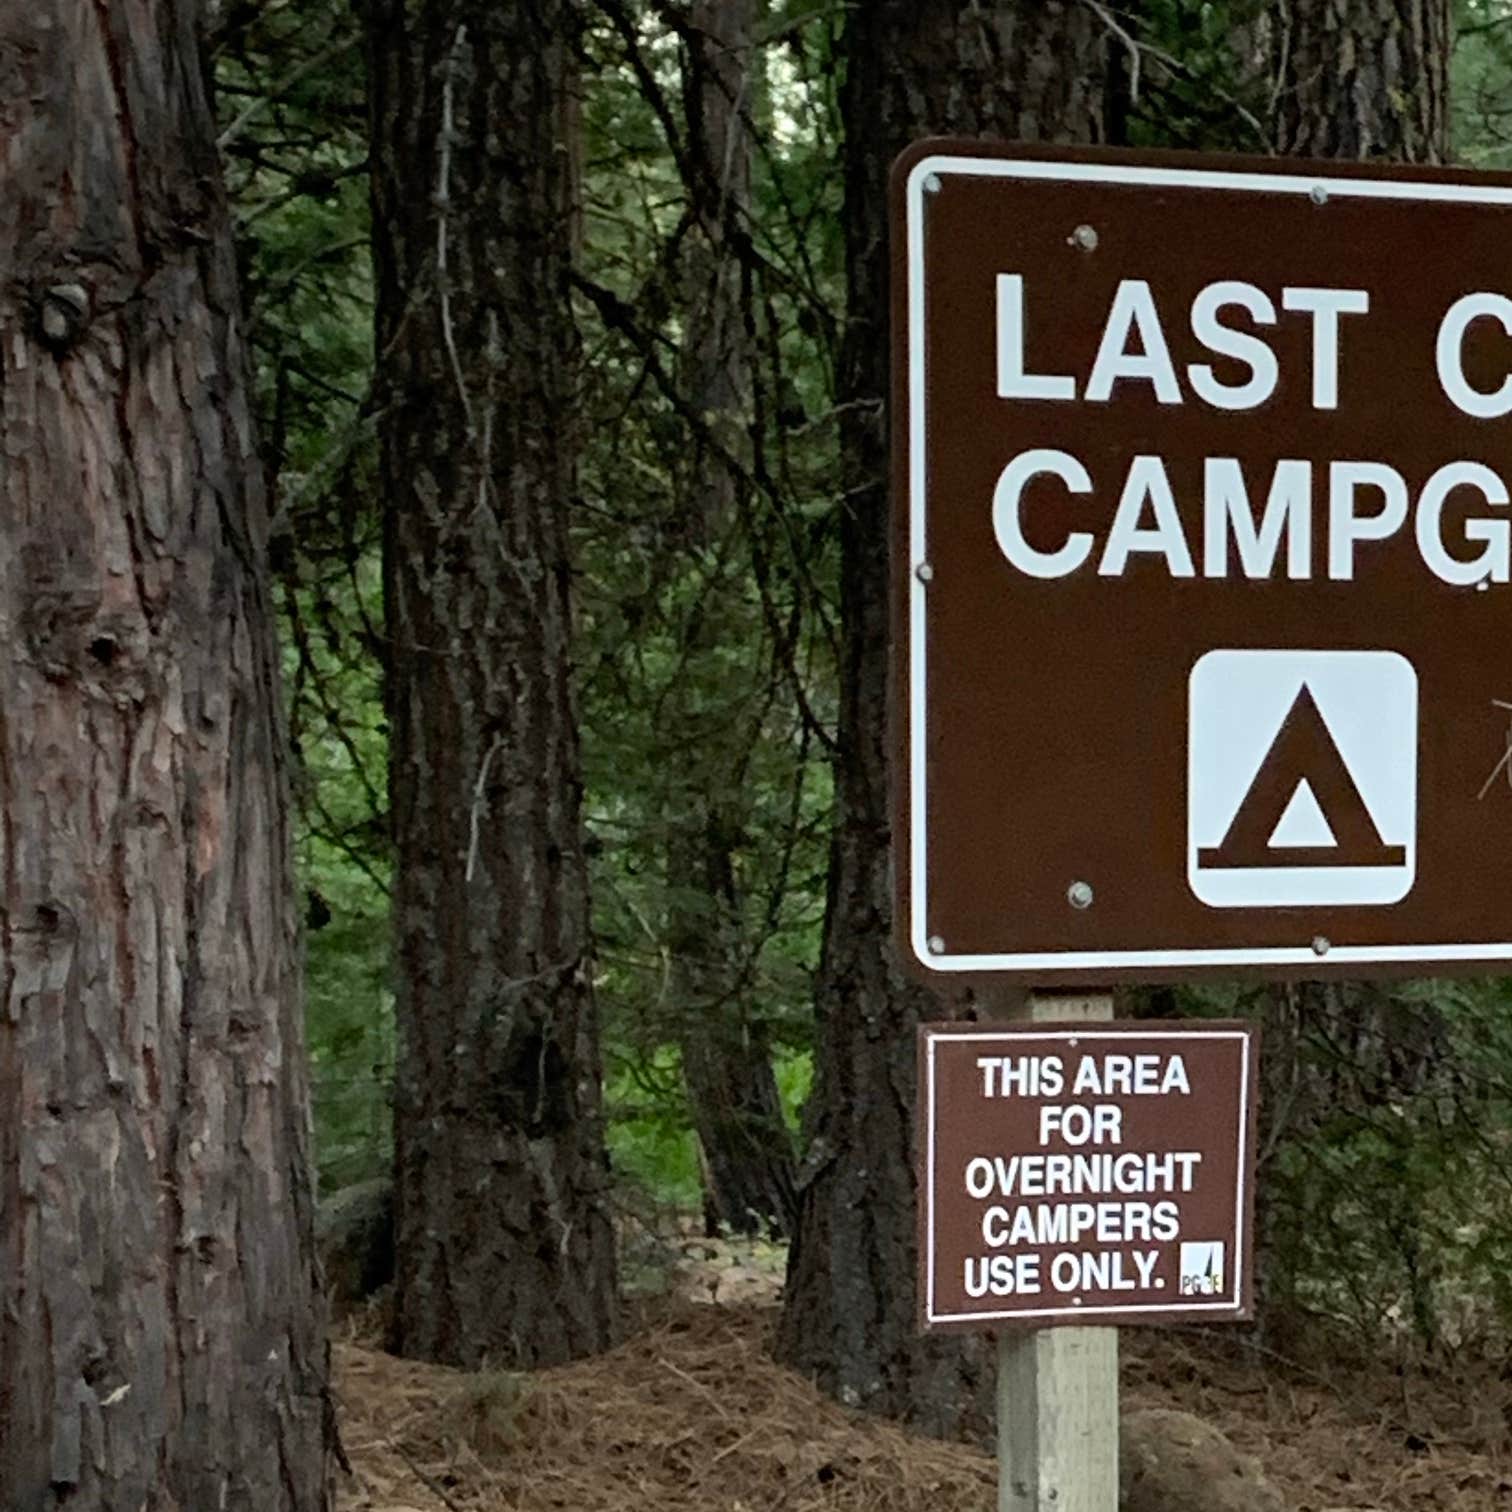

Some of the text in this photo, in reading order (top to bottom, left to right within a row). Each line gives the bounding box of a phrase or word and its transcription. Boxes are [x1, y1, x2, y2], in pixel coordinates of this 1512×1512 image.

[996, 273, 1369, 411] LAST
[976, 1054, 1191, 1098] THIS AREA
[1039, 1104, 1122, 1146] FOR
[965, 1152, 1202, 1199] OVERNIGHT
[982, 1201, 1180, 1248] CAMPERS
[964, 1250, 1165, 1298] USE ONLY.
